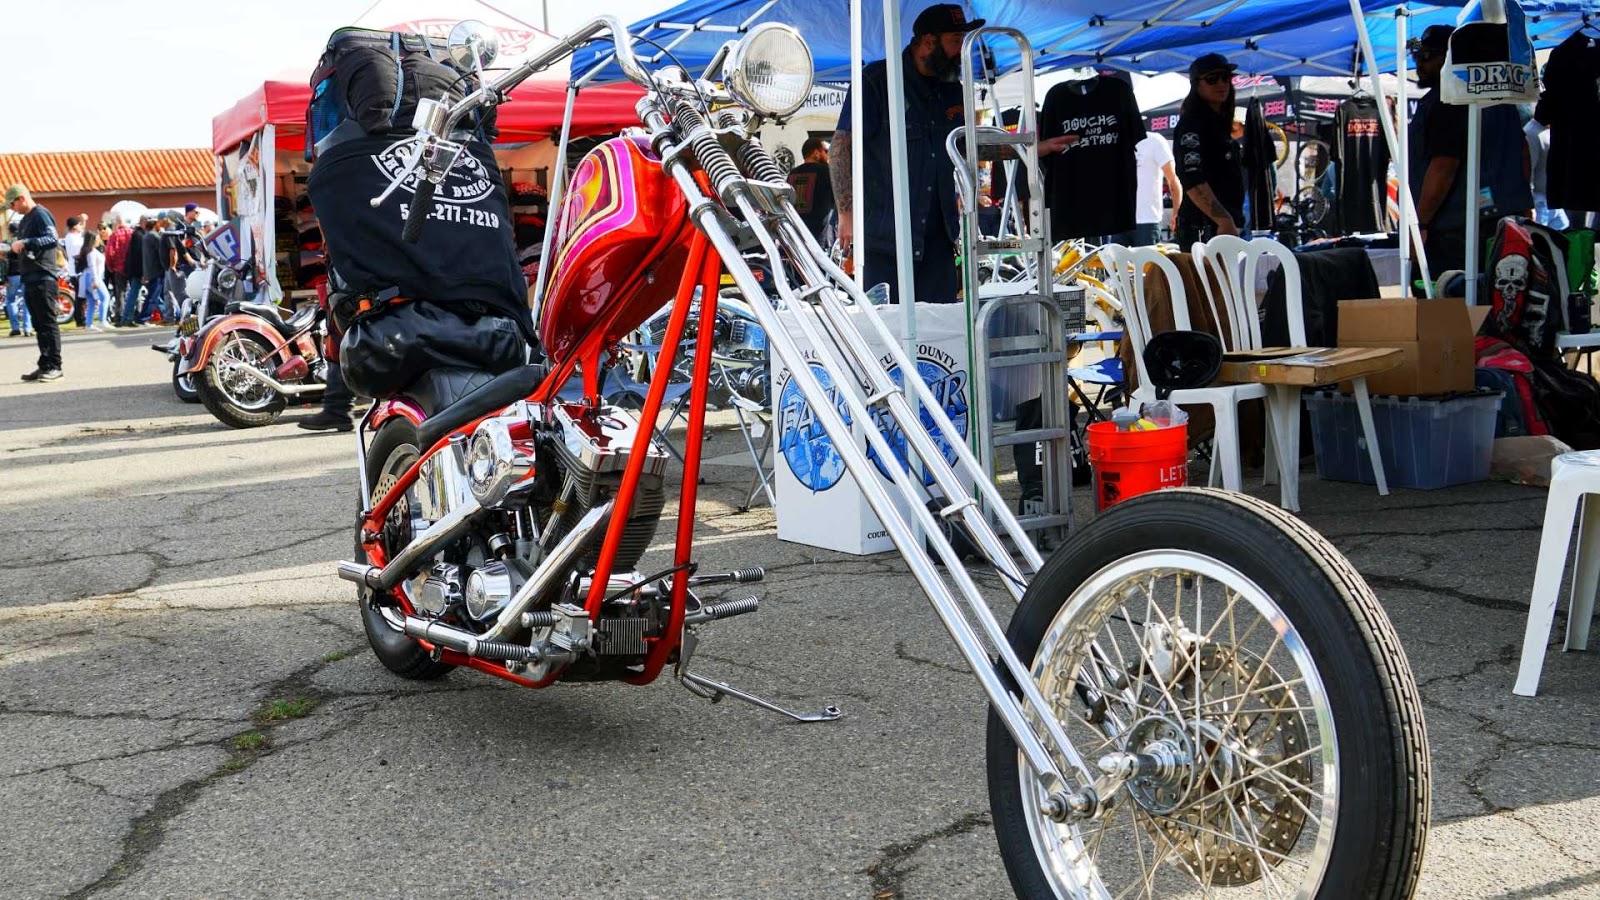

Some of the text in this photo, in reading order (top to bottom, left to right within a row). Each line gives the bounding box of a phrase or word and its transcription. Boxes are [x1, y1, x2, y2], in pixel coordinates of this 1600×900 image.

[1467, 64, 1525, 86] DRAG
[1062, 115, 1117, 134] DOUCHE
[1085, 127, 1102, 135] AND
[400, 203, 499, 229] 5-277-7219
